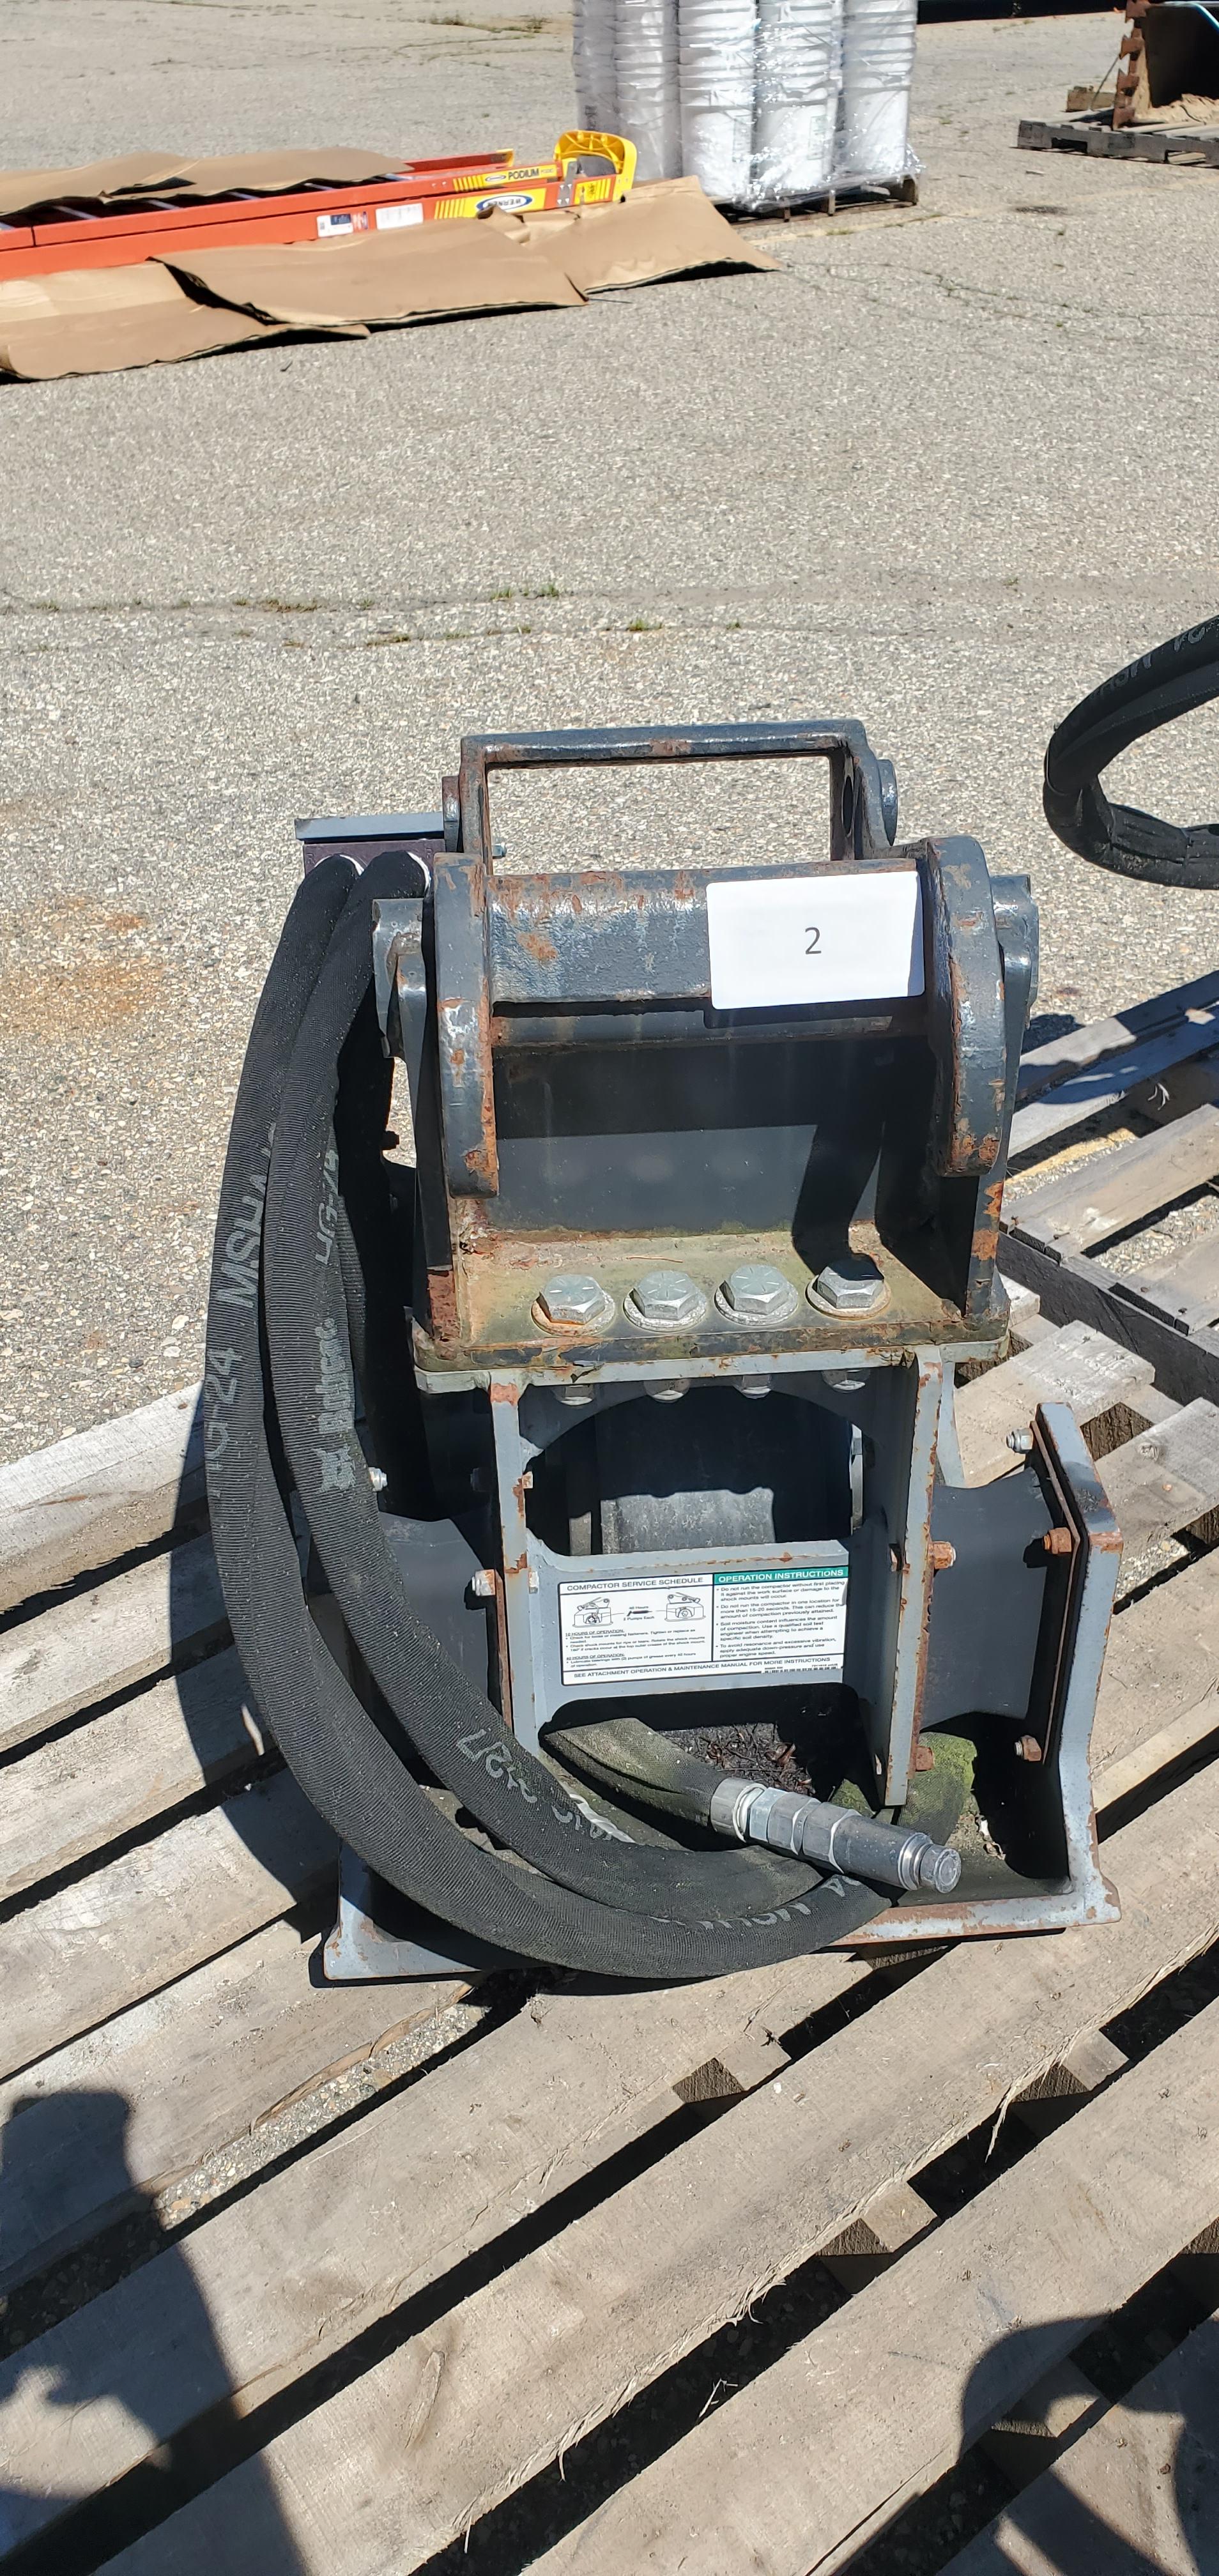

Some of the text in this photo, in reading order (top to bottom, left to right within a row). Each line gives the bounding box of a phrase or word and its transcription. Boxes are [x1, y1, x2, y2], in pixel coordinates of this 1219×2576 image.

[508, 168, 539, 180] PODIUM
[805, 927, 822, 955] 2
[718, 1569, 843, 1582] OPERATION INSTRUCTIONS
[567, 1582, 619, 1591] COMPACTOR
